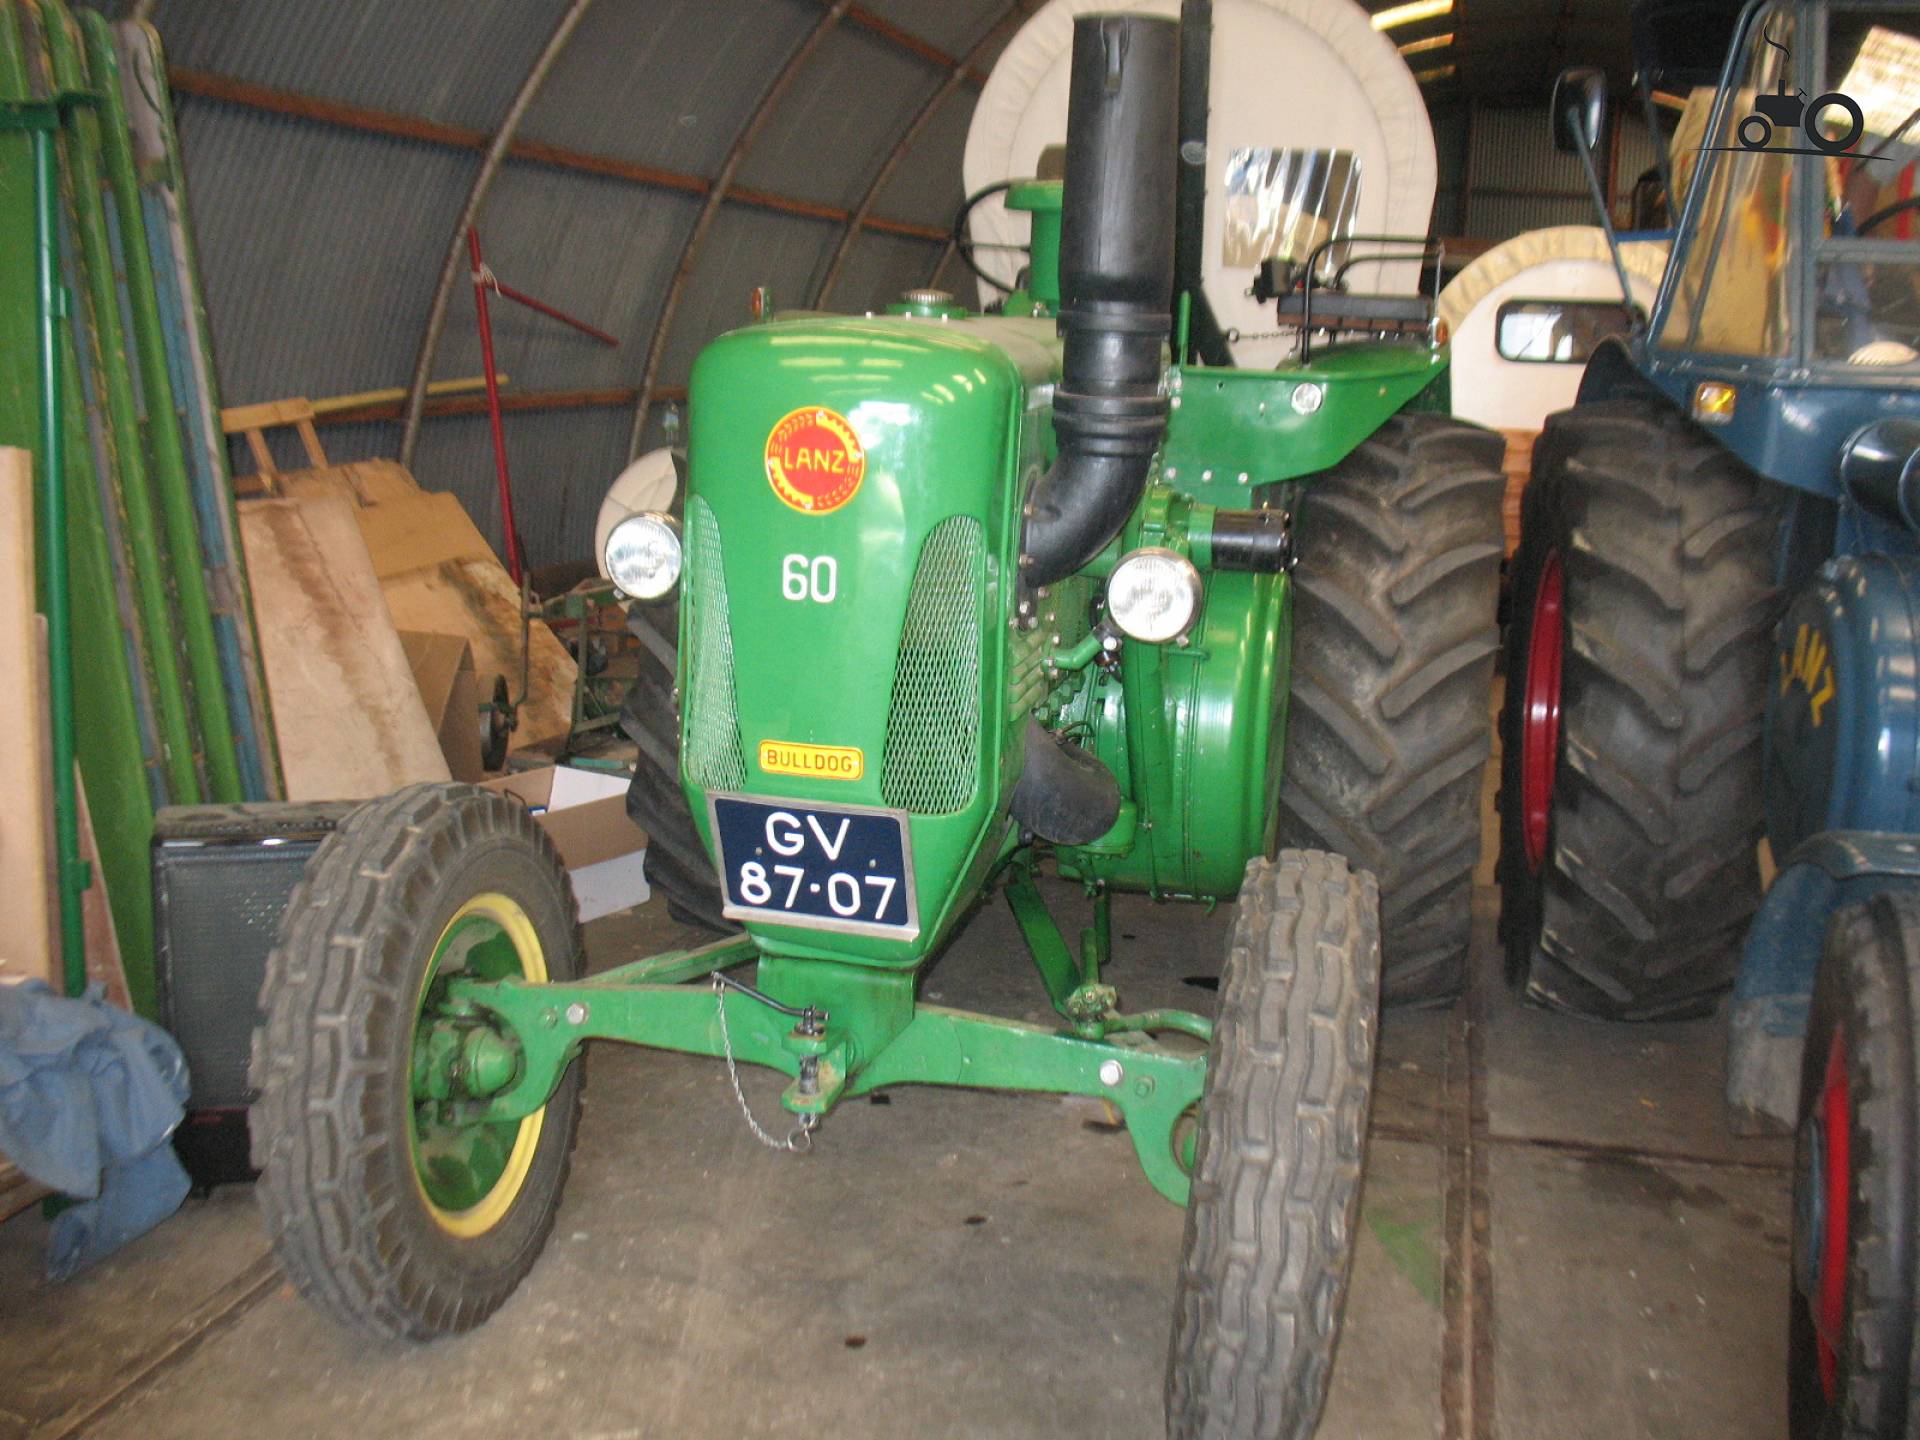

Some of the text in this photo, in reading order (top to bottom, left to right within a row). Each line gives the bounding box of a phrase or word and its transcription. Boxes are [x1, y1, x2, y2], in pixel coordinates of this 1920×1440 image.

[784, 447, 845, 474] LANZ
[782, 553, 838, 603] 60
[766, 749, 853, 773] BULLDOG
[765, 811, 851, 861] GV
